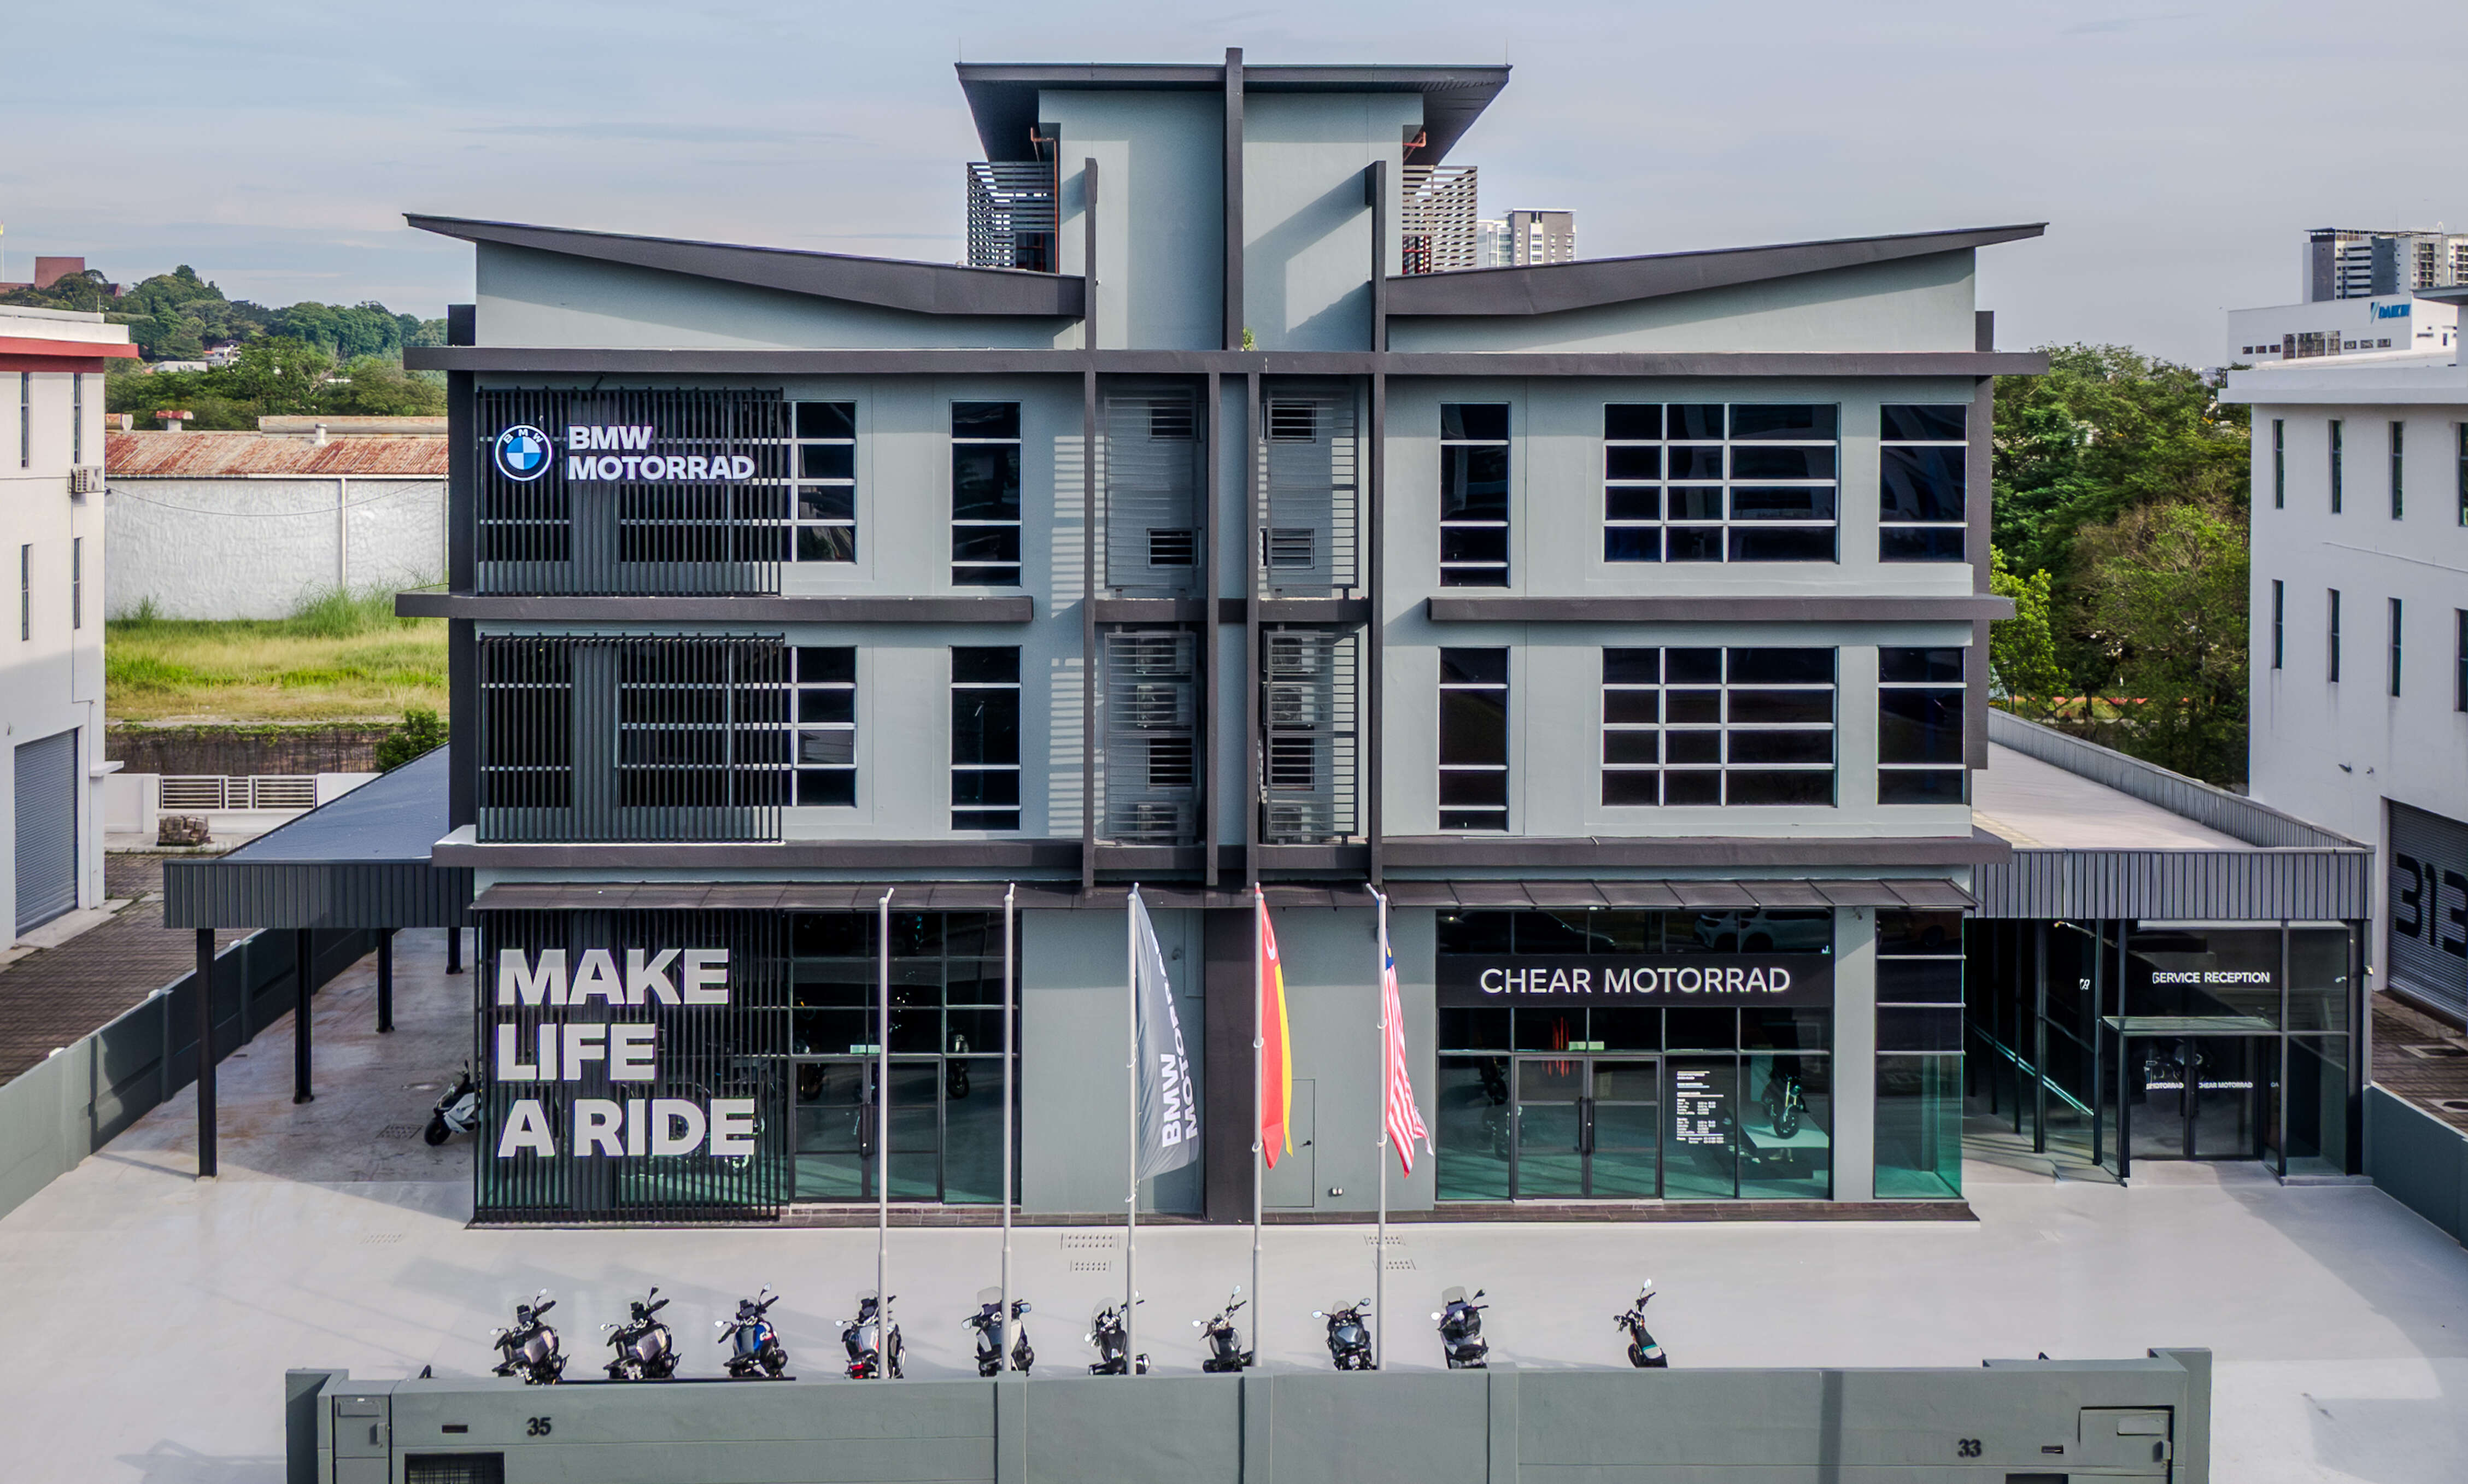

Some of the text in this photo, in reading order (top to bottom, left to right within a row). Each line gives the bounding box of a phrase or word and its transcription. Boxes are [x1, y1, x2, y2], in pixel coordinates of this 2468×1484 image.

[503, 429, 544, 444] BMW
[568, 425, 653, 450] BMW
[568, 455, 755, 480] MOTORRAD
[2395, 853, 2468, 959] 313
[498, 948, 729, 1005] MAKE
[1480, 967, 1791, 993] CHEAR MOTORRAD
[2153, 971, 2270, 984] SERVICE RECEPTION
[498, 1023, 656, 1081] LIFE
[1160, 1053, 1182, 1148] BMW
[498, 1098, 755, 1158] A RIDE
[526, 1417, 551, 1436] 35
[1958, 1439, 1982, 1458] 33
